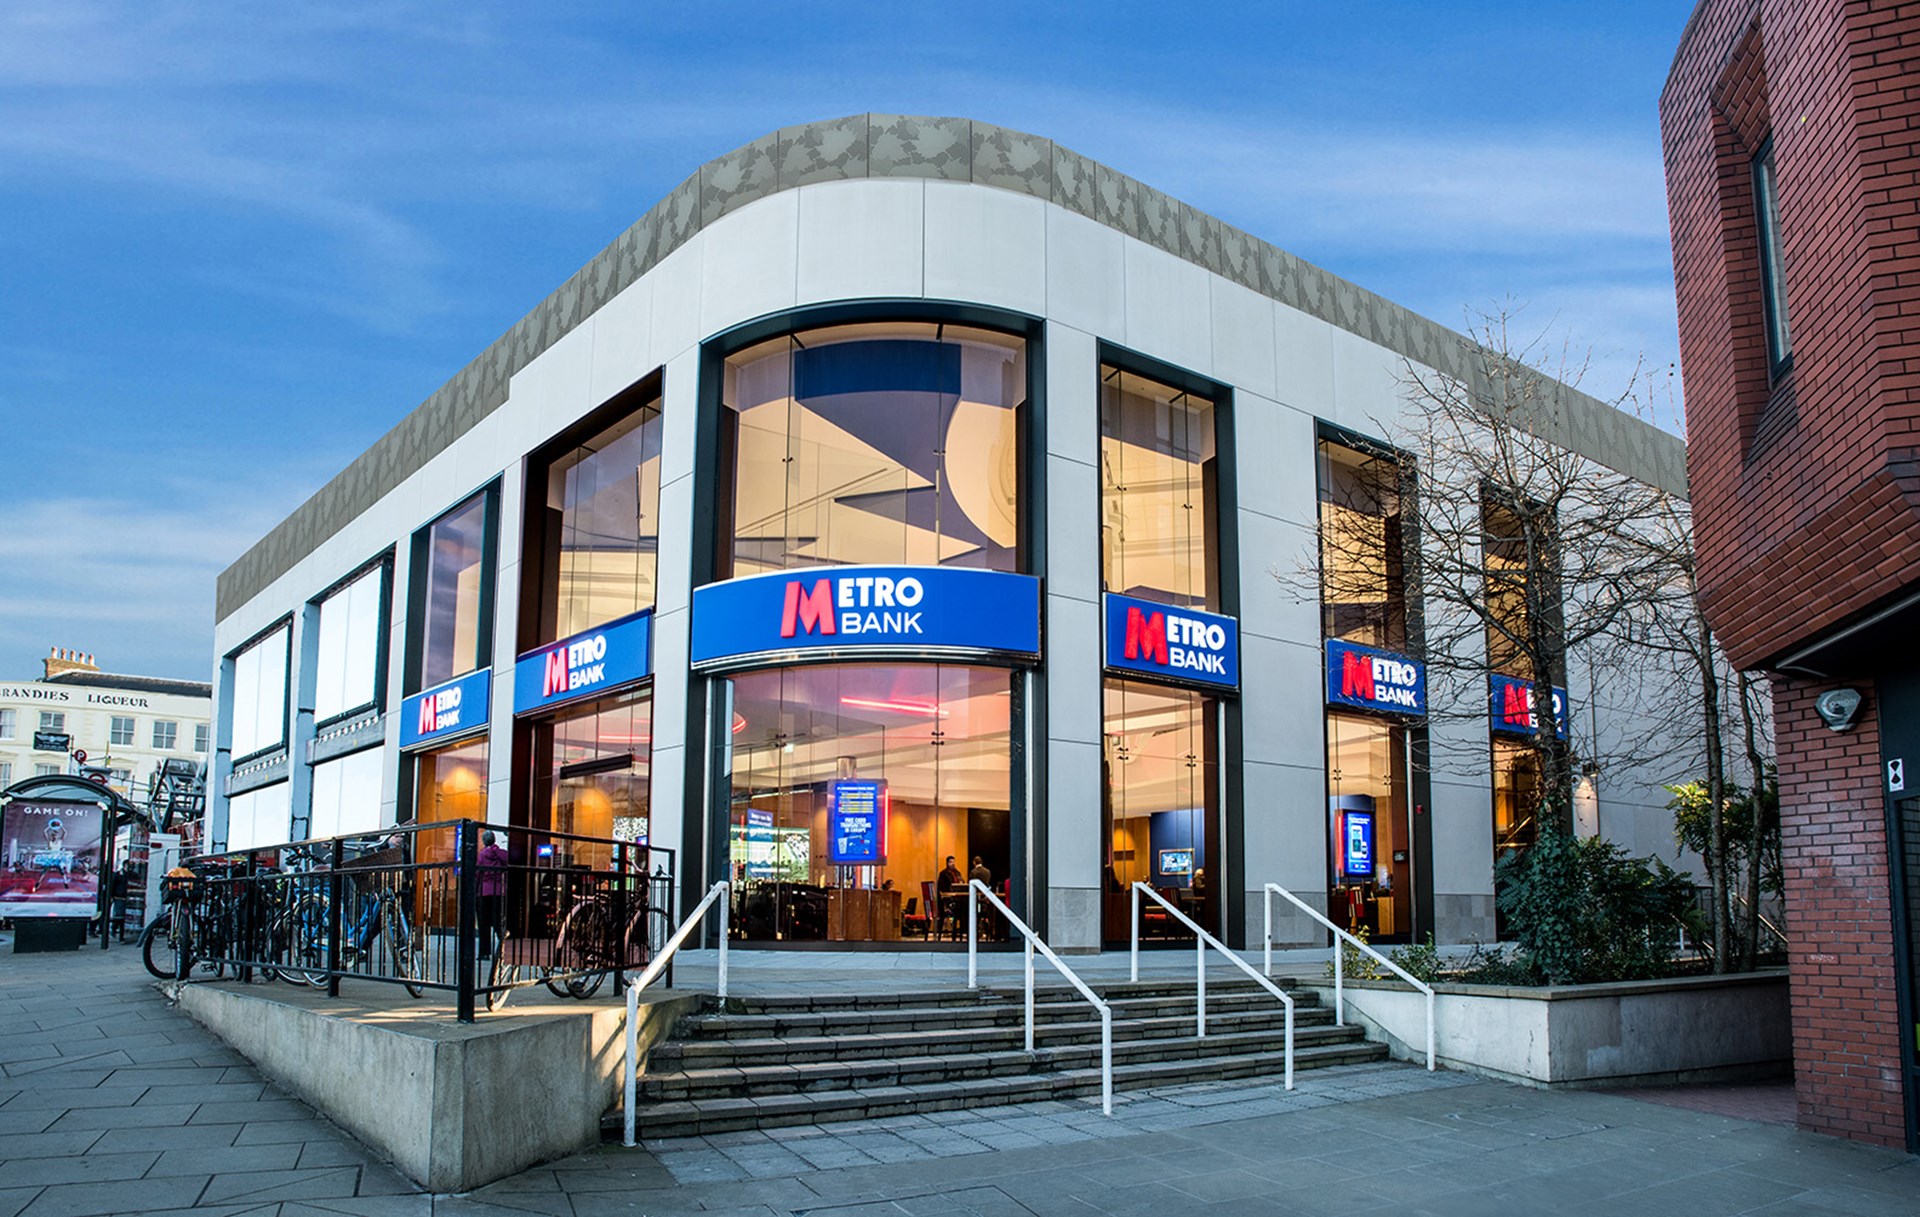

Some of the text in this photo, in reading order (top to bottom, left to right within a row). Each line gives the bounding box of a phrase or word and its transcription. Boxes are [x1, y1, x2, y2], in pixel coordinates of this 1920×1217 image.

[780, 577, 924, 638] METRO
[841, 612, 923, 634] BANK
[1124, 606, 1226, 665] METRO
[543, 634, 607, 697] METRO
[1170, 647, 1226, 675] BANK
[569, 662, 605, 690] BANK
[1342, 651, 1416, 700] METRO
[0, 688, 148, 707] RANDIES LIQUEUR
[1375, 685, 1417, 707] BANK
[418, 686, 462, 735] METRO
[436, 709, 460, 730] BANK
[78, 751, 85, 760] P
[24, 807, 88, 817] GAME ON!
